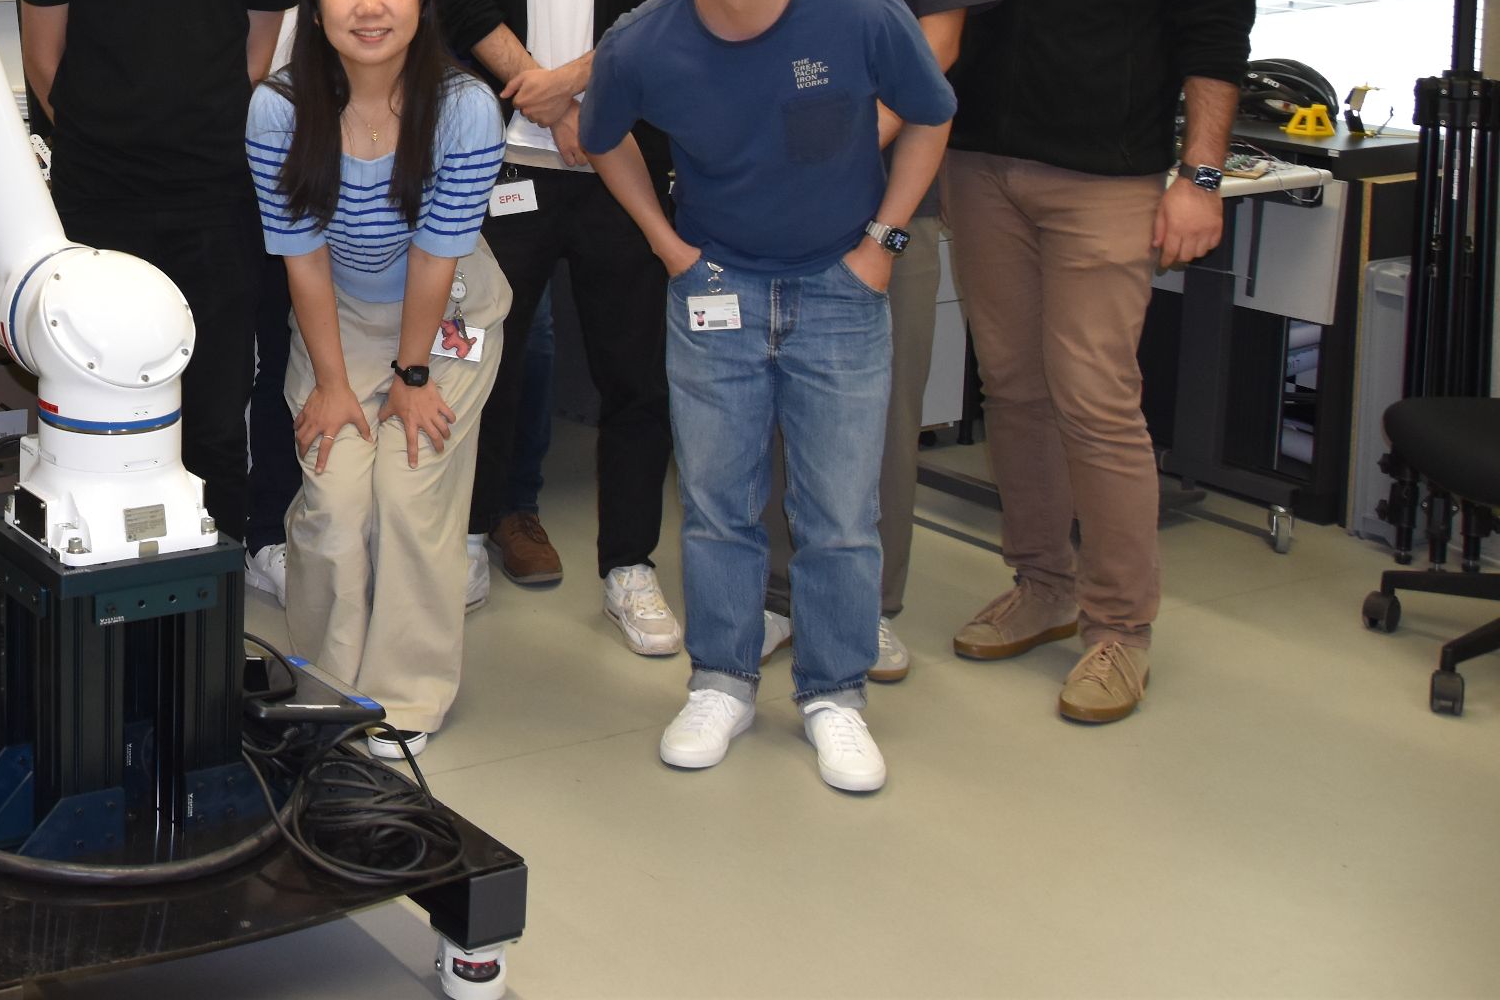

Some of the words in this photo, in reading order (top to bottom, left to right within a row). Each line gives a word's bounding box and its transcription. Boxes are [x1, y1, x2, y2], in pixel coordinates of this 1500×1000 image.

[791, 58, 810, 67] THE
[793, 61, 823, 73] GREAT
[795, 66, 829, 77] PACIFIC
[796, 73, 818, 83] IRON
[796, 77, 829, 89] WORKS
[499, 193, 525, 204] EPFL
